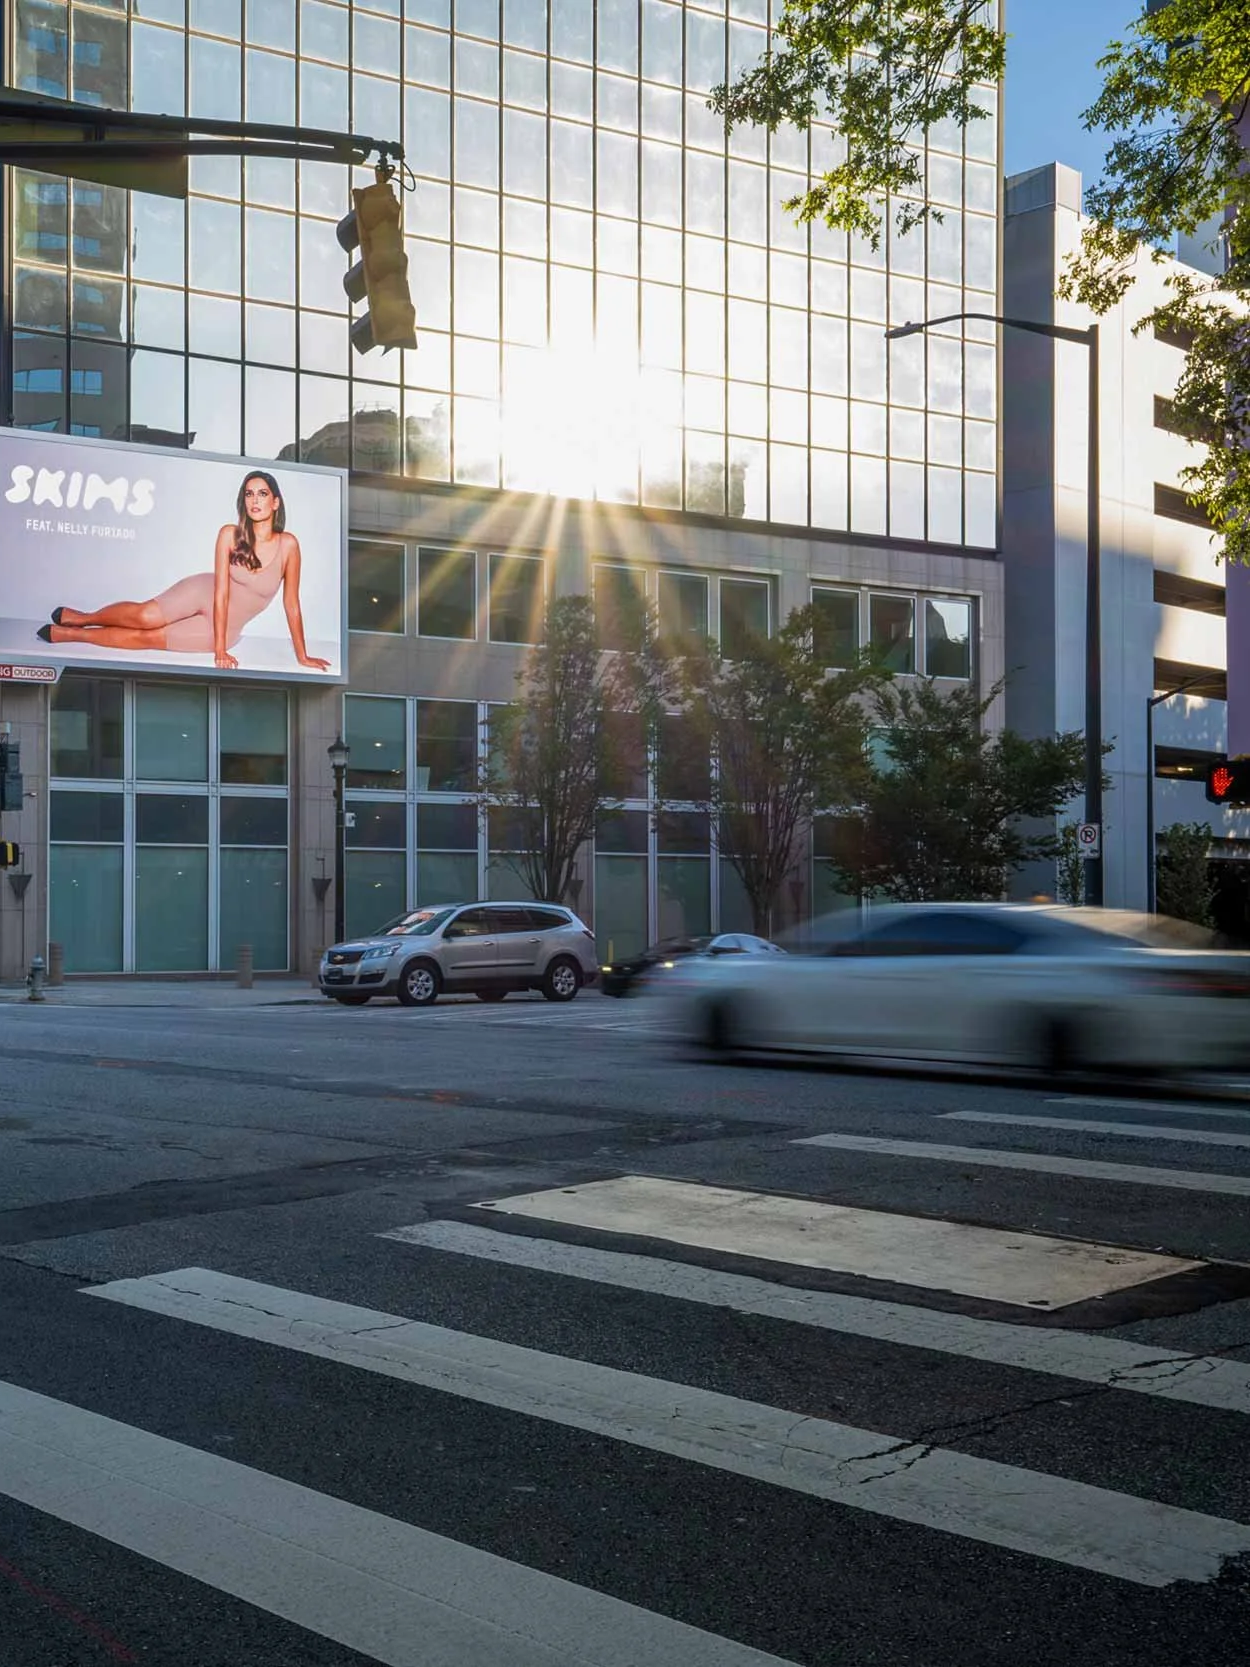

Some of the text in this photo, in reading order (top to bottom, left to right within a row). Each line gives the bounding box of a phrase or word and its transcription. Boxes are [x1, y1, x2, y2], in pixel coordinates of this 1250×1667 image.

[4, 464, 156, 516] SKIMS
[26, 519, 136, 540] FEAT. NELLY FURTADO
[13, 668, 54, 677] OUTDOOR
